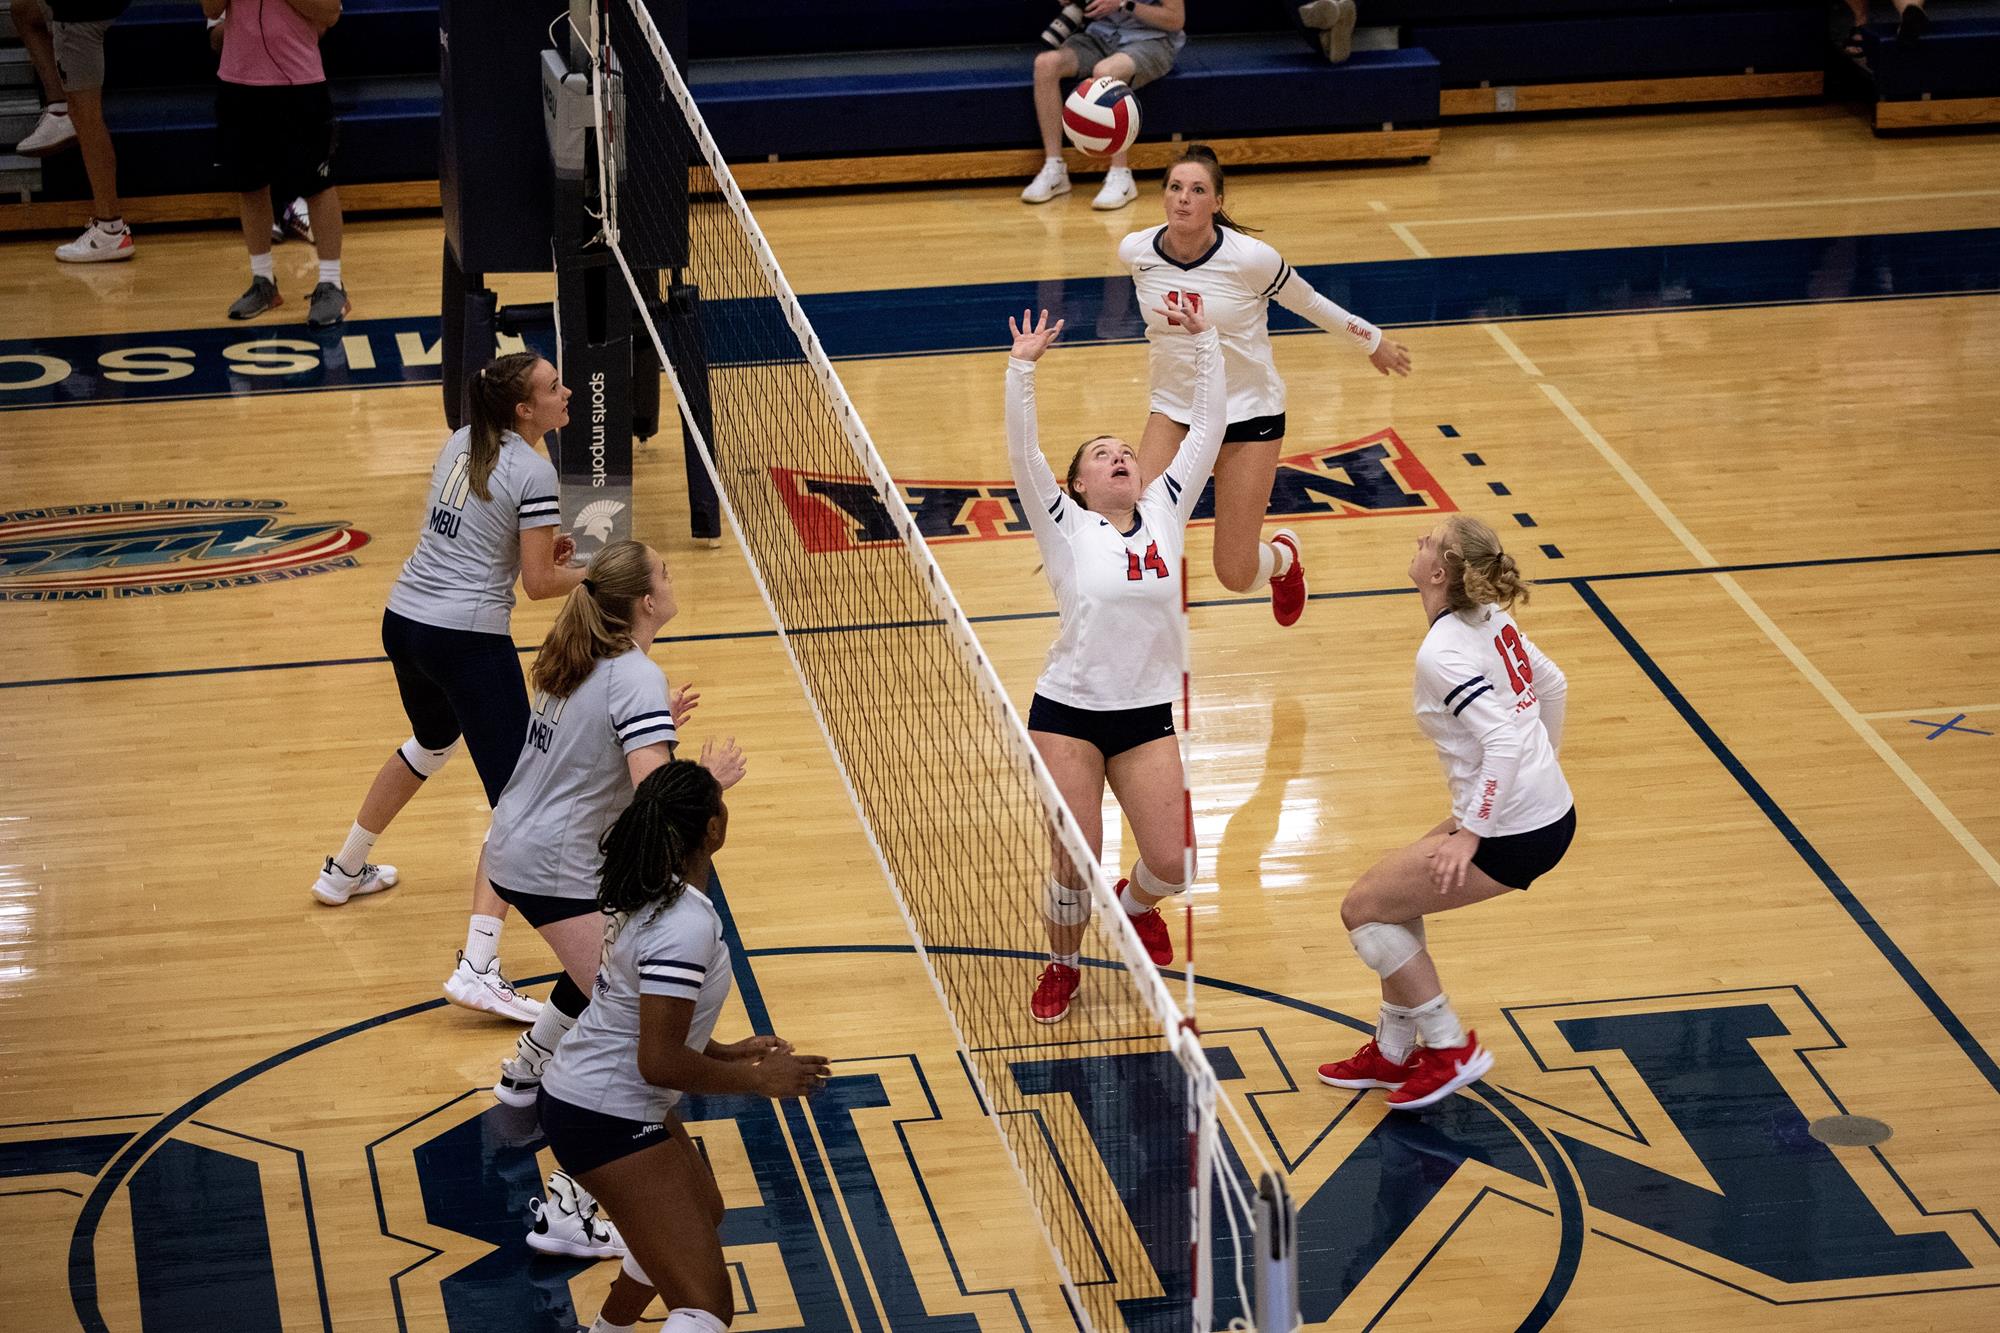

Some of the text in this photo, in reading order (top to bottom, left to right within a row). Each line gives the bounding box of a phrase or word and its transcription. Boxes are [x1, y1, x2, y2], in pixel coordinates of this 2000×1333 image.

[589, 372, 607, 488] sports imports
[429, 506, 461, 539] MBU
[0, 554, 361, 602] AMERICAN MID
[1125, 539, 1170, 581] 14
[1494, 623, 1534, 696] 13
[528, 719, 553, 754] MBU
[1477, 778, 1497, 820] TROJANS
